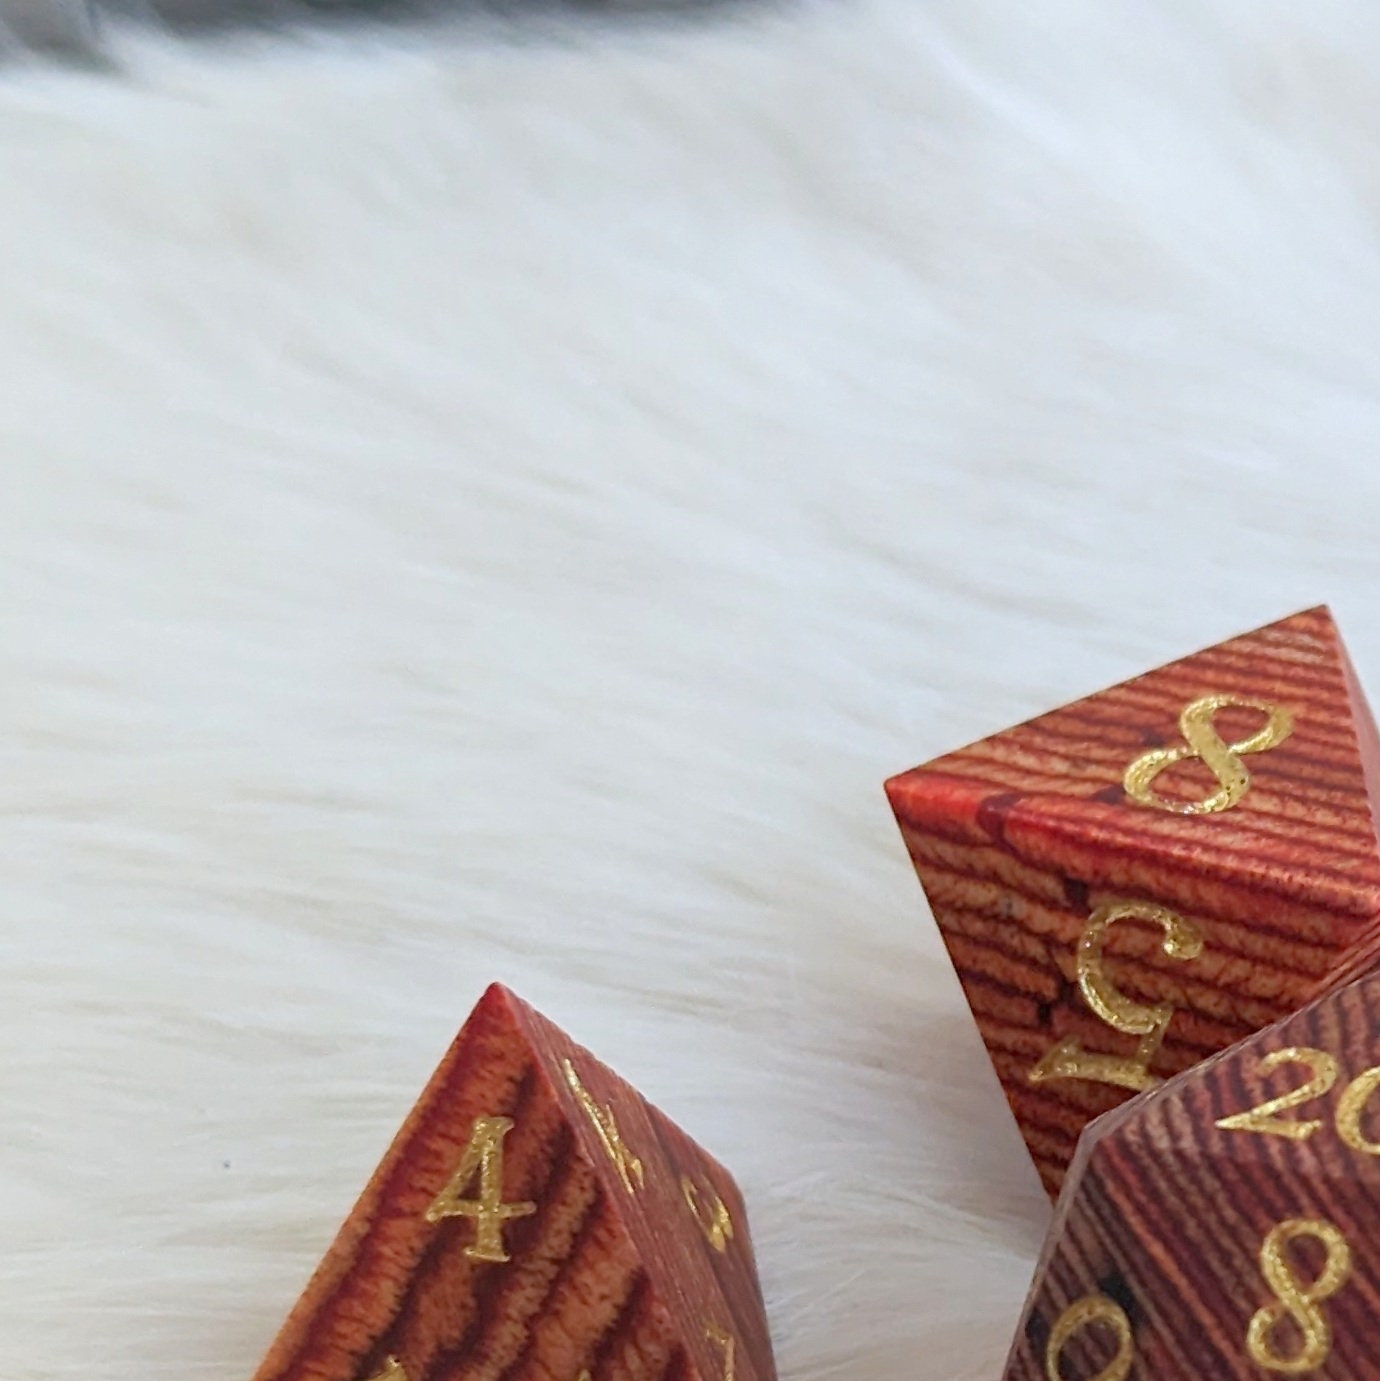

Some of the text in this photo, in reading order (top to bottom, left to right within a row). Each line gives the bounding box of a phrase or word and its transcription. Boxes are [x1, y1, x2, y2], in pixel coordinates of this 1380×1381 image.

[1123, 694, 1294, 815] 8
[1028, 901, 1204, 1093] 5
[428, 1116, 535, 1262] 4
[1246, 1218, 1351, 1375] 8
